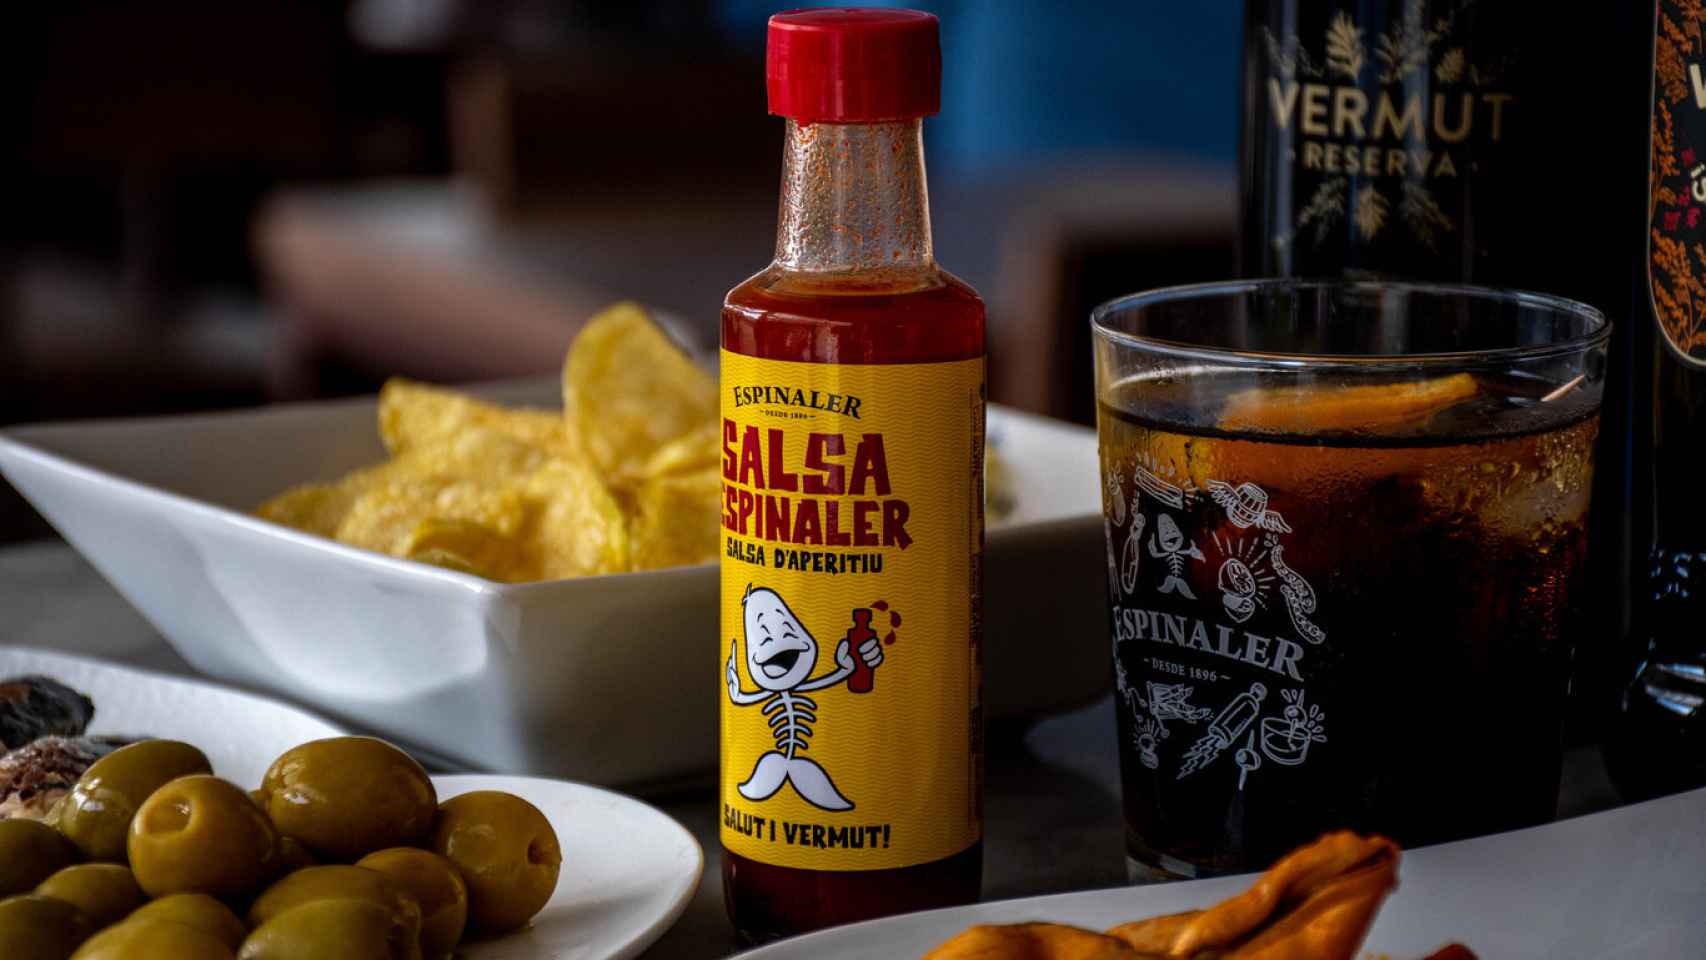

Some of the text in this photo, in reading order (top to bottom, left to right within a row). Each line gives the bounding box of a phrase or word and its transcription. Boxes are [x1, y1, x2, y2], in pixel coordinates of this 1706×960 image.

[1268, 78, 1514, 143] VERMUT
[1304, 141, 1457, 177] RESERVA
[733, 385, 862, 419] ESPINALER
[723, 417, 892, 496] SALSA
[727, 536, 883, 575] SALSA D'APERITIU
[1112, 605, 1305, 682] ESPINALER
[1152, 657, 1217, 682] DESDE 1896
[724, 804, 890, 850] SALUT I VERMUT!
